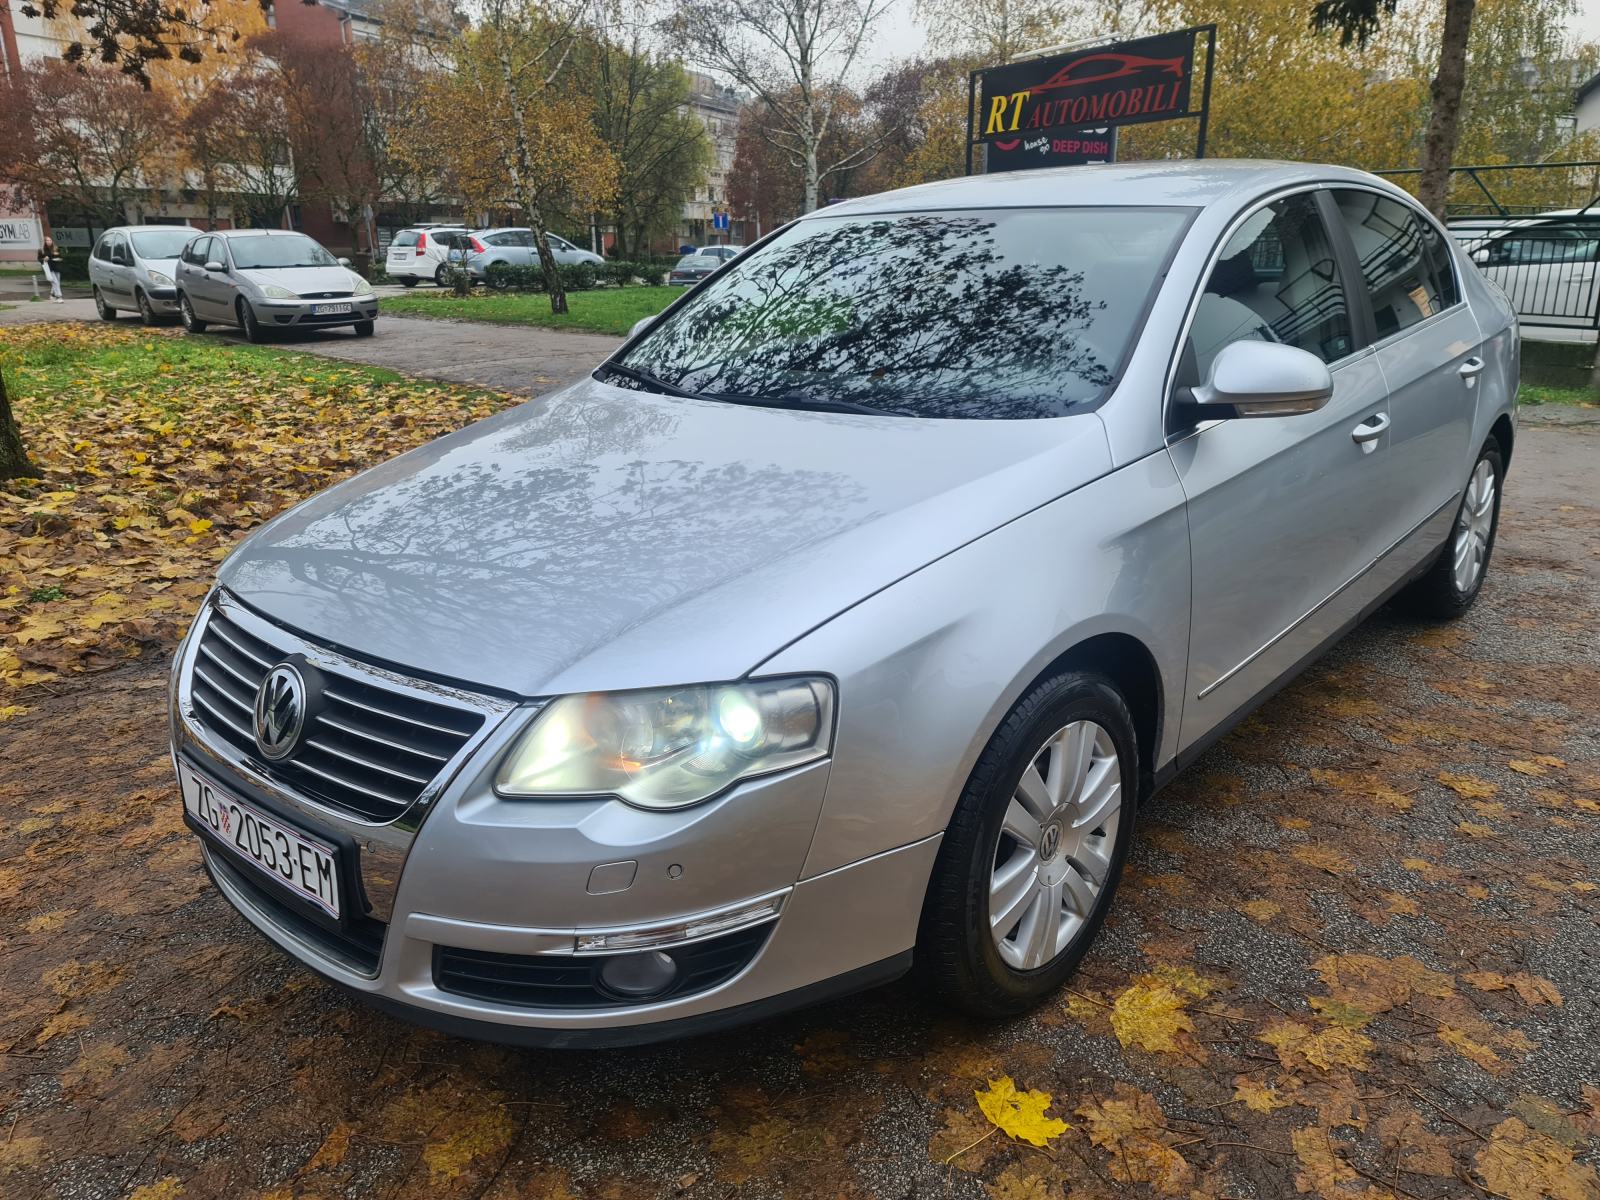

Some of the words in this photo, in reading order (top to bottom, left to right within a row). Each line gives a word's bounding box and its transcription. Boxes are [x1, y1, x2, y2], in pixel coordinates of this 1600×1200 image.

[985, 91, 1030, 134] RT
[1026, 81, 1182, 129] AUTOMOBILI
[1052, 140, 1080, 153] DEEP
[1082, 141, 1108, 154] DISH
[192, 775, 219, 831] ZG
